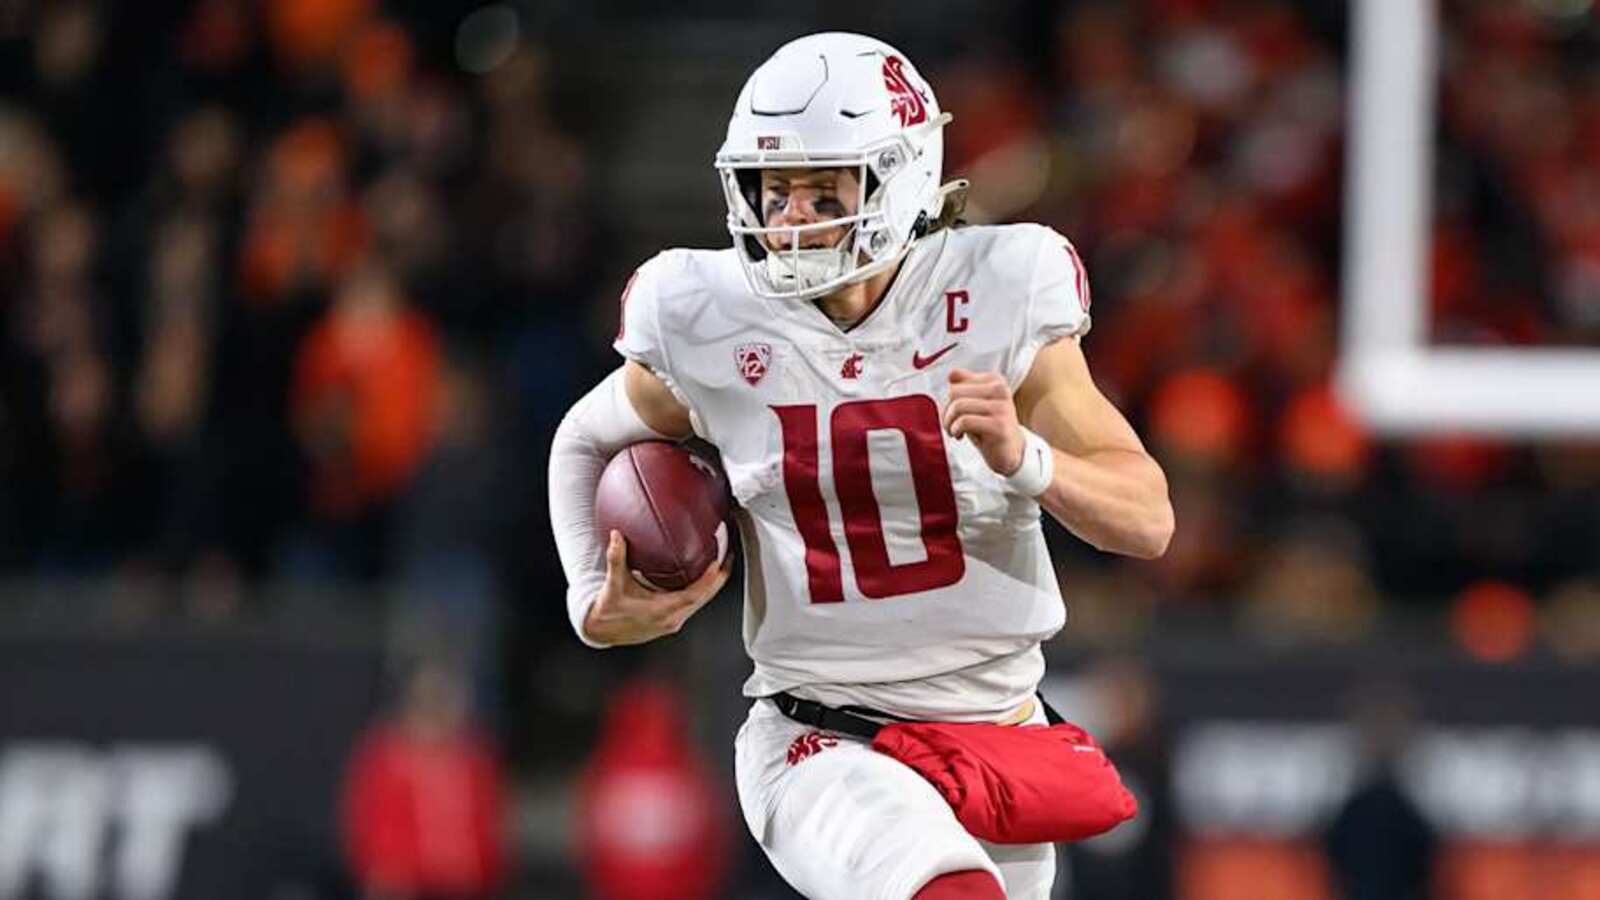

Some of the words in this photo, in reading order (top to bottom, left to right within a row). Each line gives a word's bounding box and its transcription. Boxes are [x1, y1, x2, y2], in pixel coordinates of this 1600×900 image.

[757, 136, 780, 150] WSU
[945, 290, 969, 333] C
[744, 360, 763, 378] 12
[768, 394, 966, 604] 10
